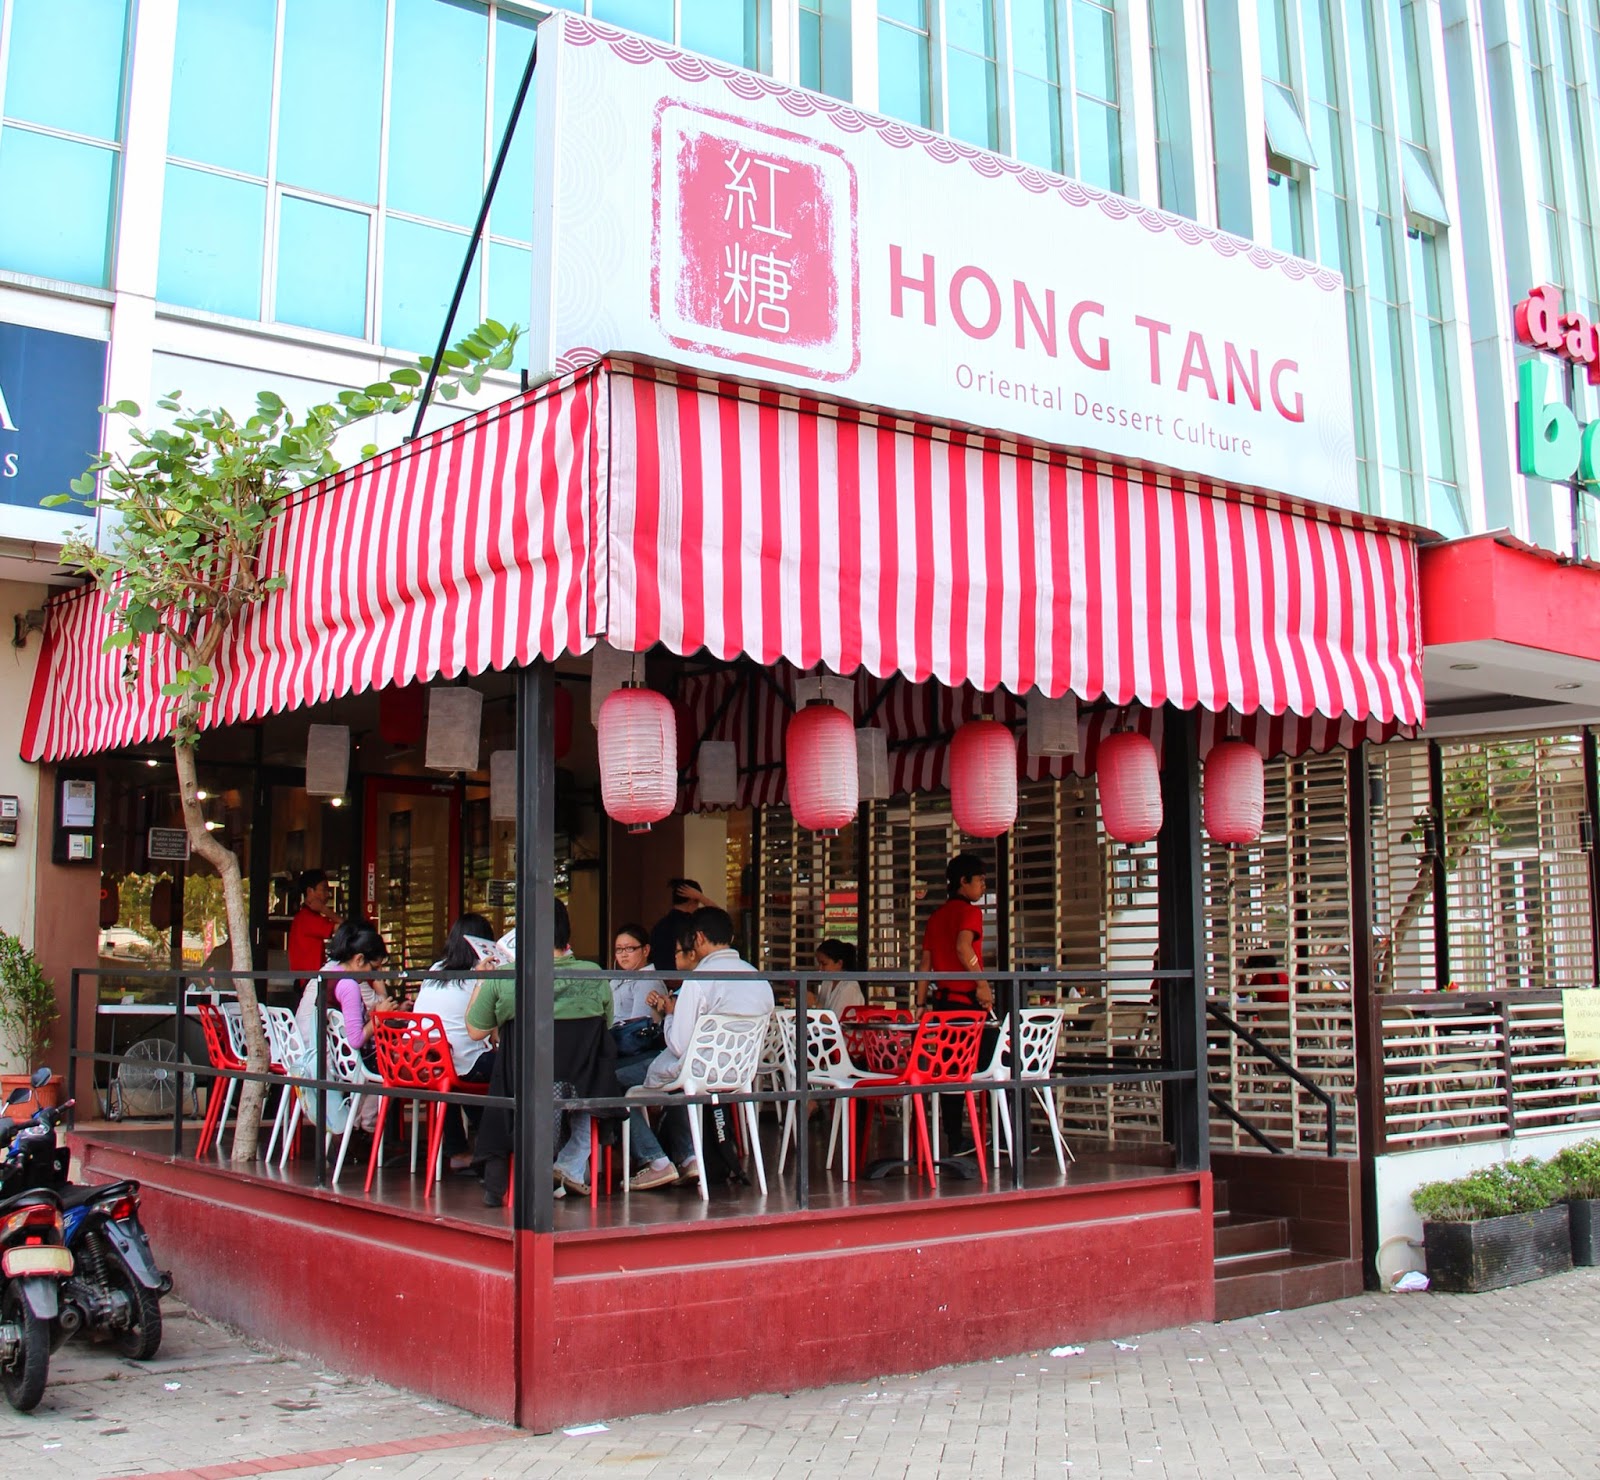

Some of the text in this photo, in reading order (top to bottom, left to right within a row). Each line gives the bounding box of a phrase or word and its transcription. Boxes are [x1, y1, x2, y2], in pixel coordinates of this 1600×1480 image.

[724, 149, 792, 333] 紅糖
[889, 244, 1305, 423] HONG TANG
[1516, 285, 1600, 386] da
[956, 364, 1252, 457] Oriental Dessert Culture
[1519, 359, 1600, 496] b
[713, 1108, 726, 1144] Wilson
